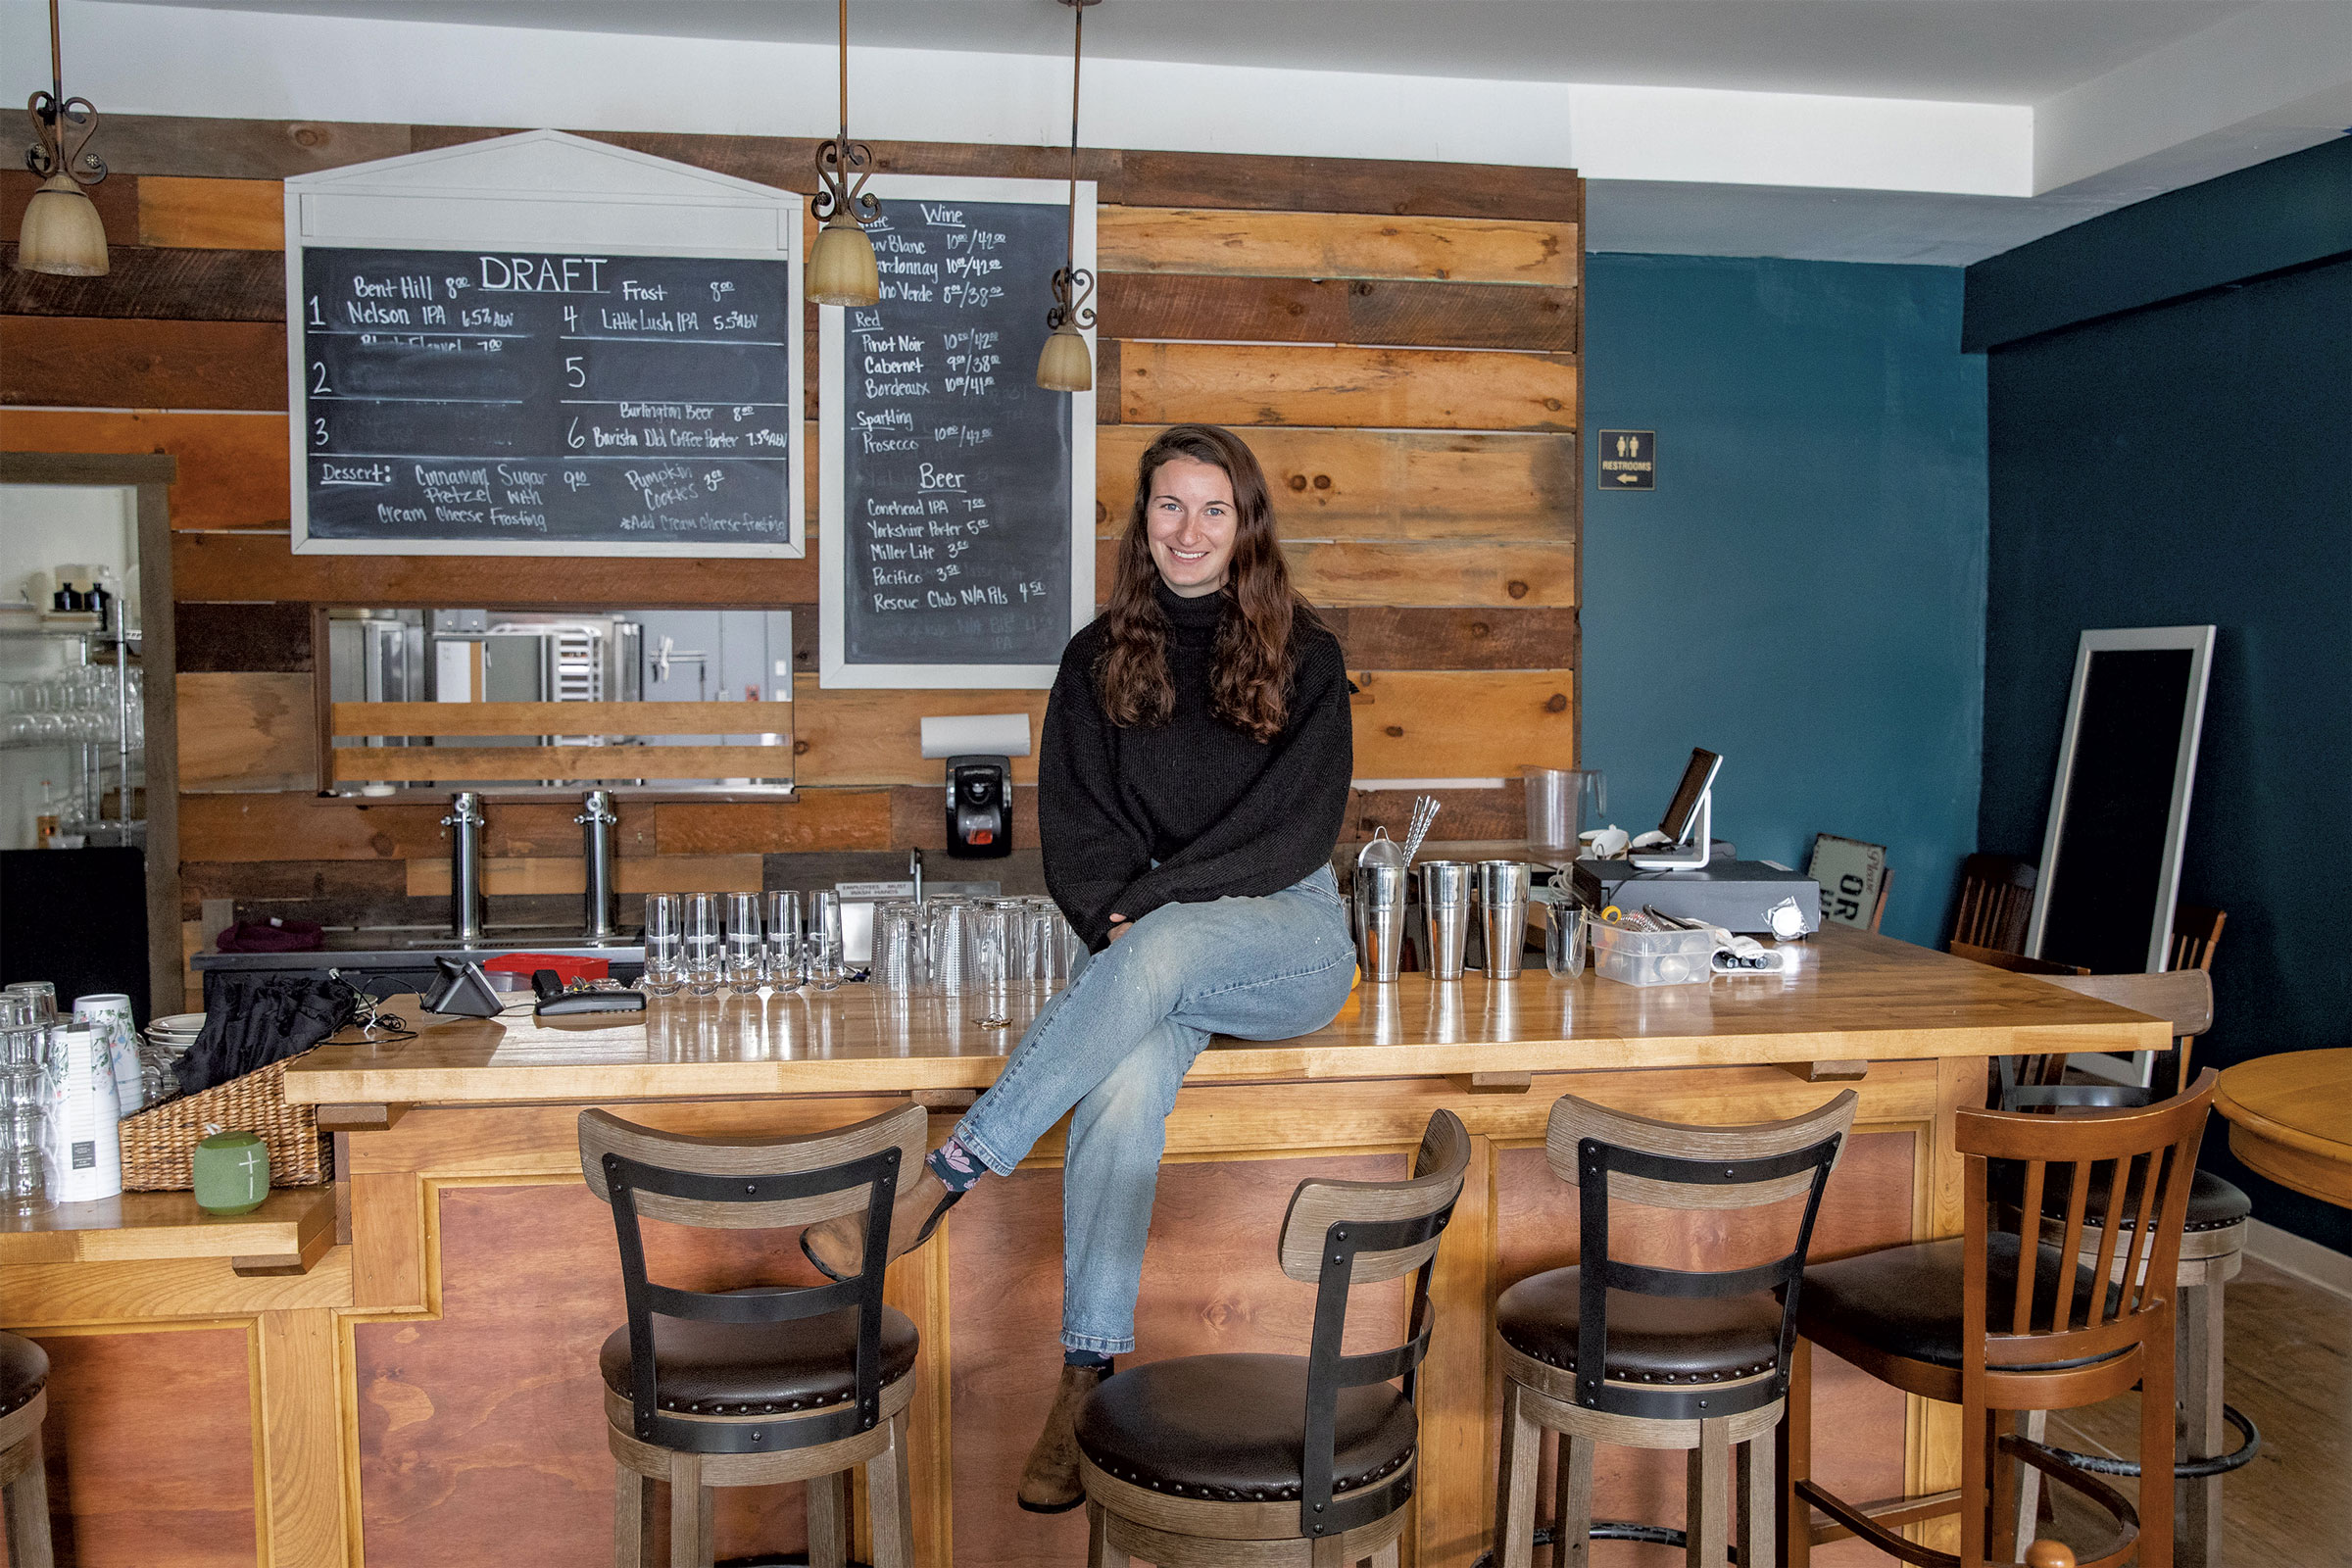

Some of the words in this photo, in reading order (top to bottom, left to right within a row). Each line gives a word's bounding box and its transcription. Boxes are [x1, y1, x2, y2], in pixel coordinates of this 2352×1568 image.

[920, 204, 964, 224] Wine
[888, 234, 926, 255] Blanc
[479, 256, 608, 292] DRAFT
[876, 257, 938, 284] ardonnay
[354, 275, 398, 297] Bent
[400, 276, 433, 300] Hill
[622, 280, 668, 301] Frost
[896, 281, 933, 303] Verde
[309, 295, 326, 325] 1
[346, 300, 411, 325] Nelson
[422, 305, 446, 325] IPA
[564, 305, 578, 332] 4
[601, 309, 638, 331] Little
[639, 309, 673, 332] Lush
[677, 312, 699, 332] IPA
[856, 310, 881, 327] Red
[862, 334, 896, 353] Pinot
[899, 335, 925, 353] Noir
[565, 357, 586, 388] 5
[864, 356, 924, 374] Cabernet
[313, 362, 332, 394] 2
[864, 377, 930, 399] Bordeaux
[619, 403, 682, 424] Burlington
[685, 404, 714, 420] Beer
[857, 409, 913, 431] Sparkling
[314, 417, 329, 445] 3
[567, 416, 585, 449] 6
[593, 426, 638, 448] Barista
[669, 430, 703, 448] Coffee
[705, 429, 739, 449] Porter
[862, 432, 919, 454] Prosecco
[321, 463, 391, 483] Dessert:
[415, 464, 490, 486] Cinnamon
[497, 463, 548, 490] Sugar
[624, 463, 694, 491] Pumpkin
[918, 463, 965, 489] Beer
[1602, 461, 1651, 471] RESTROOMS
[423, 486, 492, 504] Pretzel
[643, 481, 699, 511] Cookies
[377, 503, 427, 524] Cream
[490, 507, 548, 532] Frosting
[867, 498, 924, 516] Conehead
[928, 501, 949, 514] IPA
[867, 519, 924, 539] Yorkshire
[929, 520, 962, 538] Porter
[870, 542, 906, 562] Miller
[909, 543, 935, 560] Lite
[872, 566, 923, 586] Pacifico
[874, 593, 919, 613] Rescue
[927, 590, 956, 608] Club
[960, 585, 986, 606] N/A
[987, 586, 1007, 605] Pils
